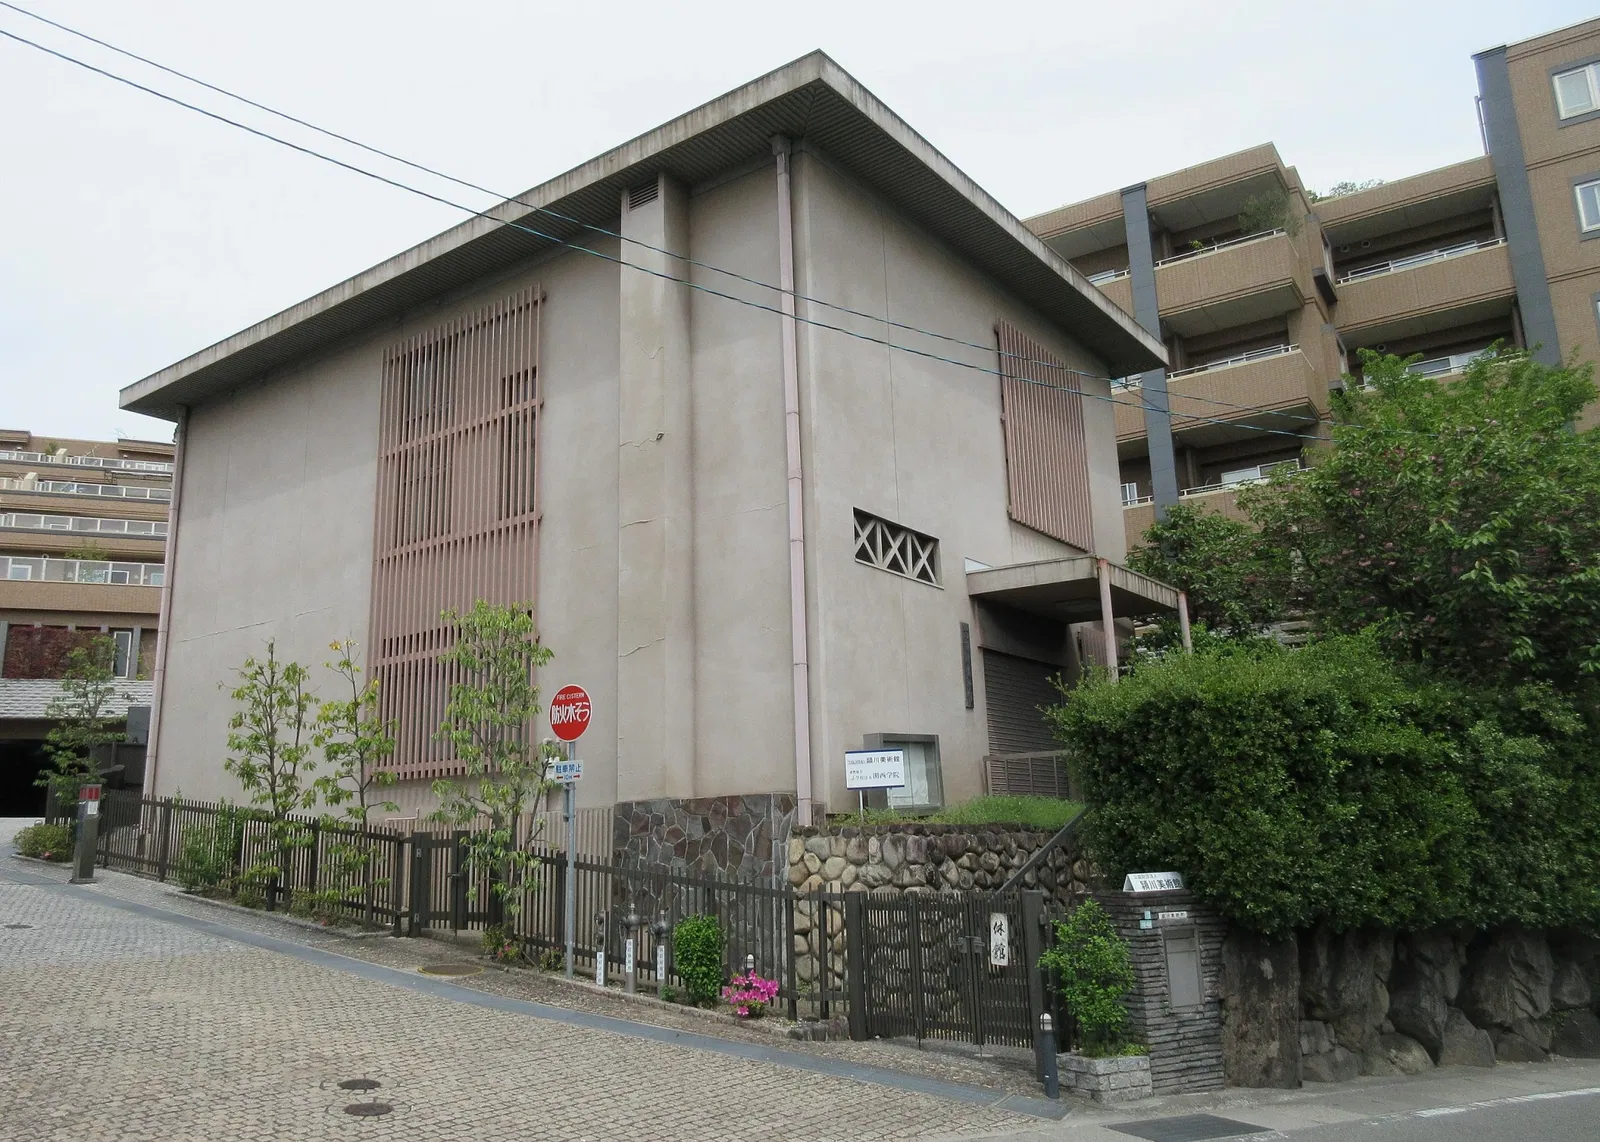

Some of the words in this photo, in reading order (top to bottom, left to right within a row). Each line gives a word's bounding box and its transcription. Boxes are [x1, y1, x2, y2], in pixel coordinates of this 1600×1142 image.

[556, 693, 566, 701] FIRE
[566, 692, 584, 700] CISTERN
[551, 702, 590, 725] 防火水そう
[555, 763, 582, 774] 駐車禁止
[992, 919, 1006, 961] 休館
